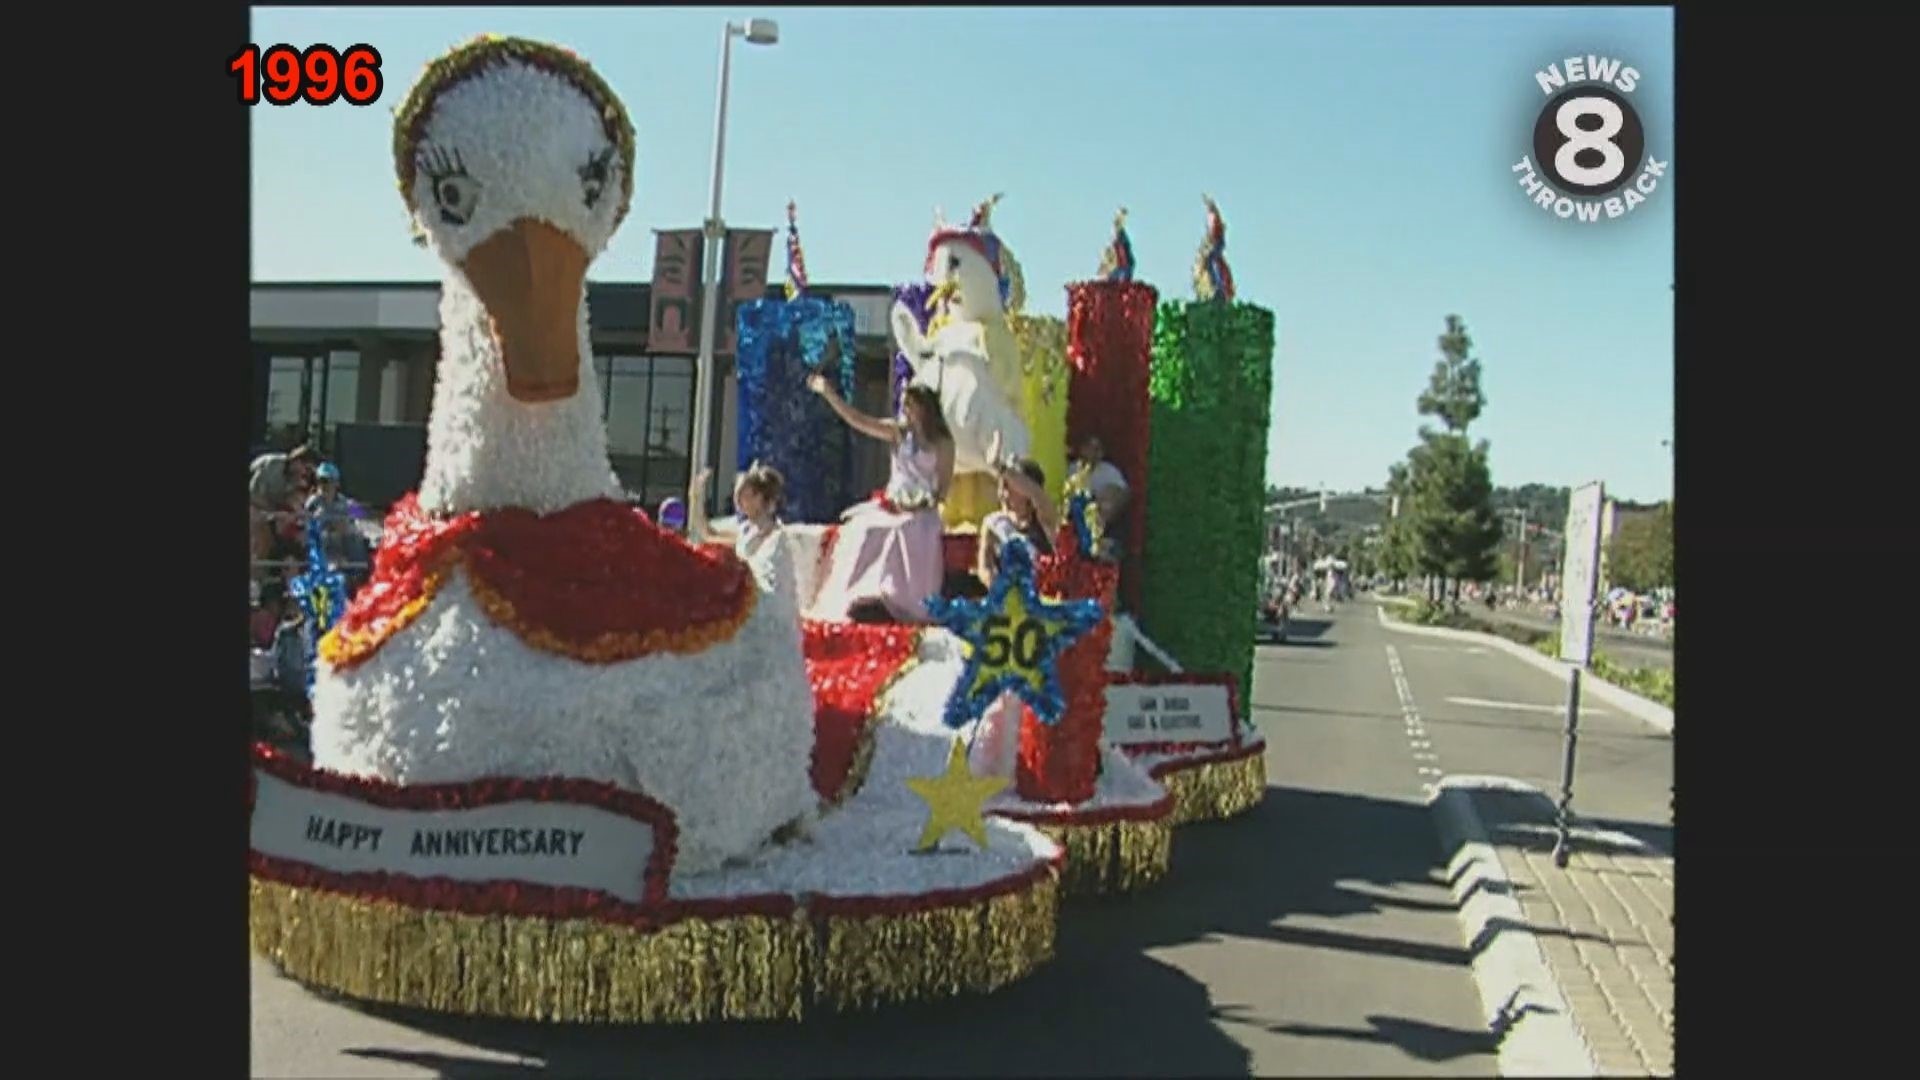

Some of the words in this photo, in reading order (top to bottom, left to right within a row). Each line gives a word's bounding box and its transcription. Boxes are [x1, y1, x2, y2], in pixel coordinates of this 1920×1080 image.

[981, 616, 1046, 668] 50
[306, 815, 383, 851] HAPPY
[410, 828, 585, 856] ANNIVERSARY
